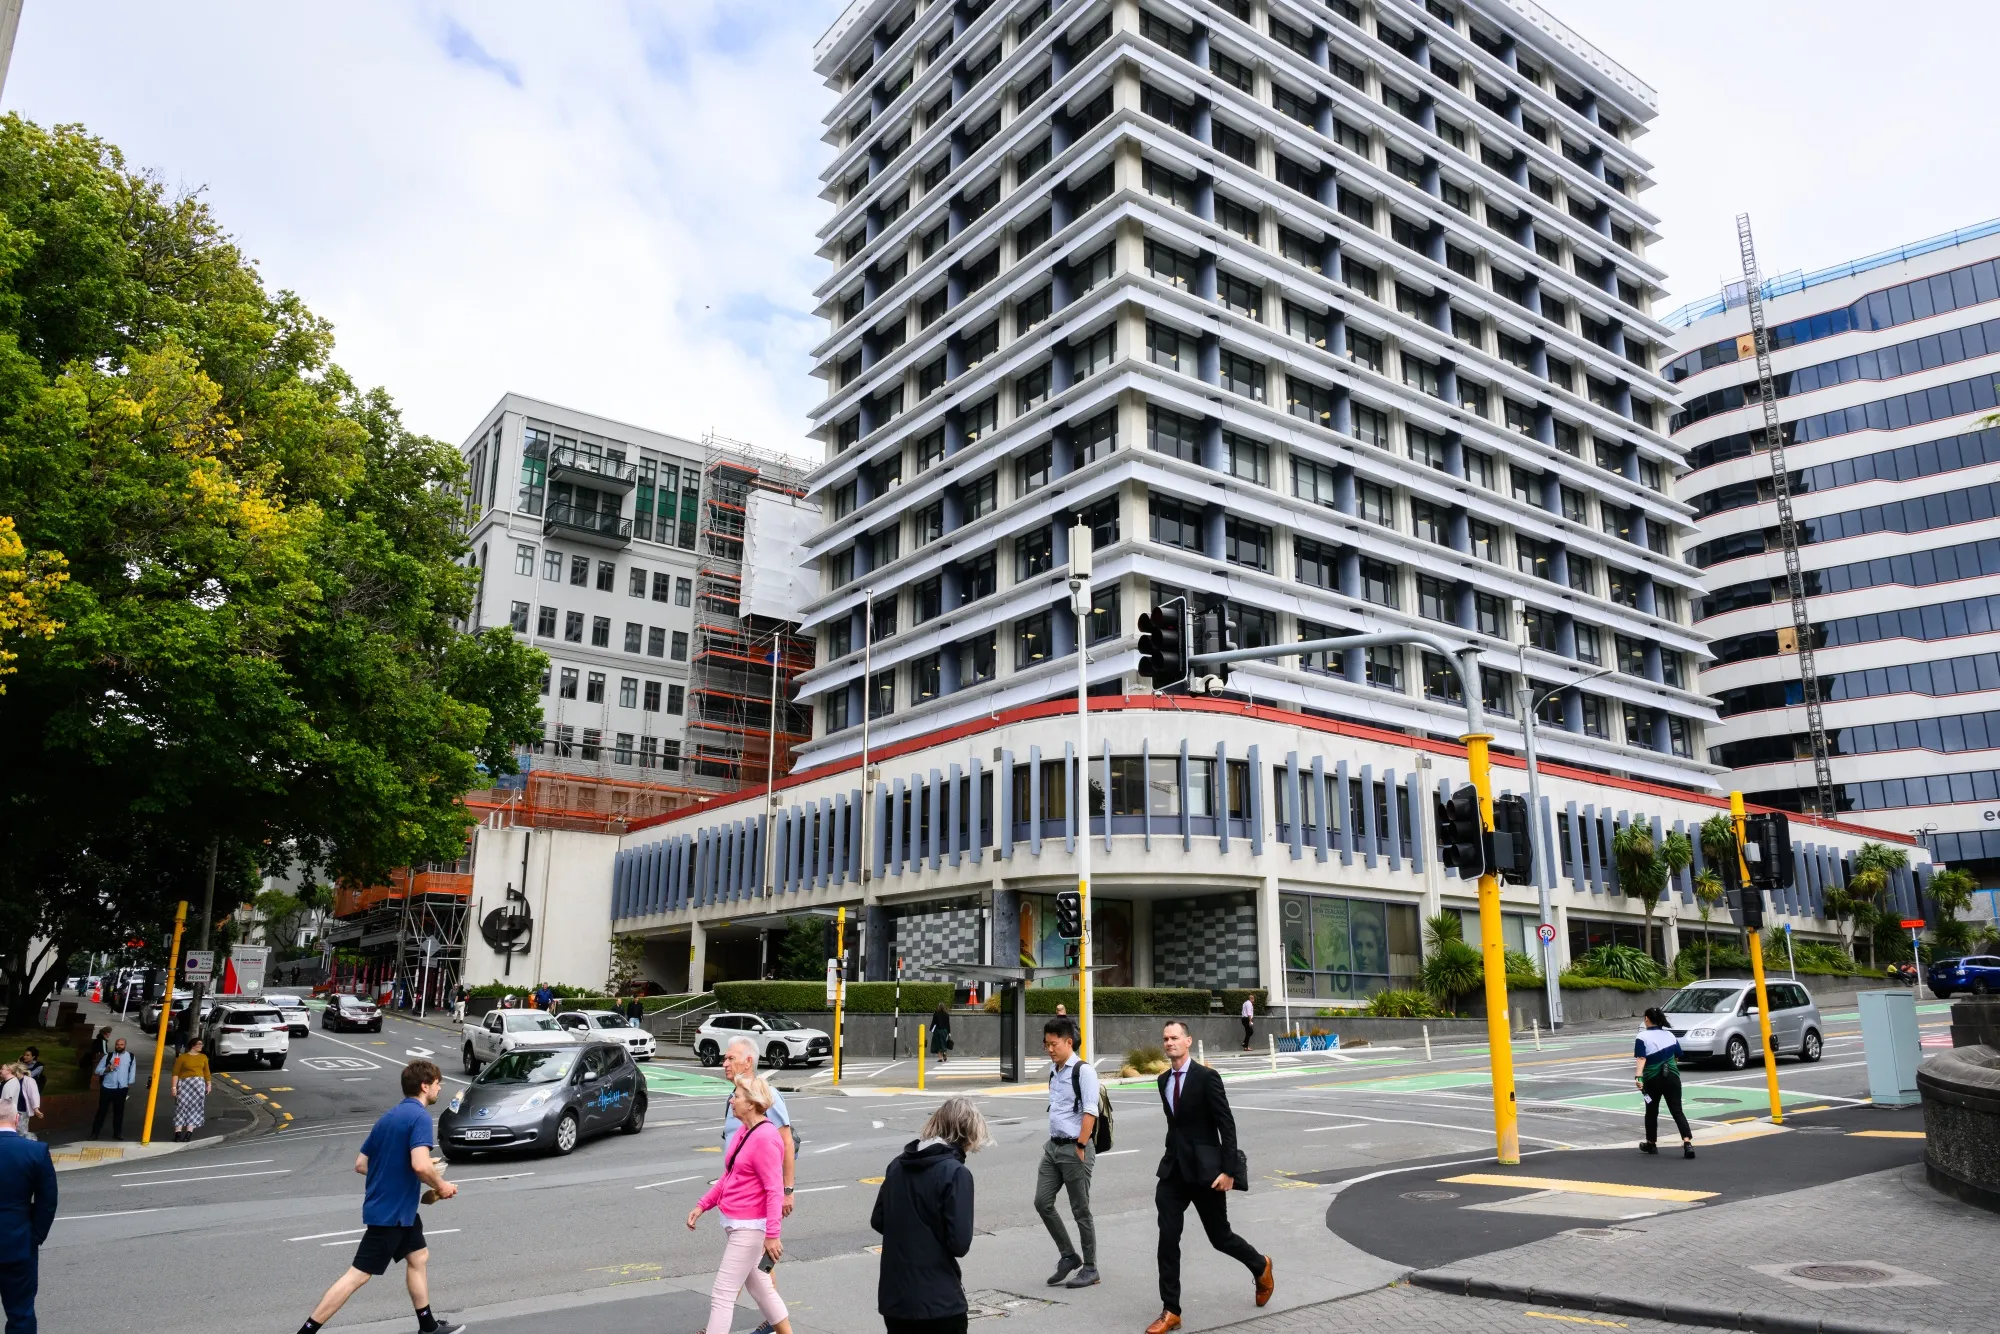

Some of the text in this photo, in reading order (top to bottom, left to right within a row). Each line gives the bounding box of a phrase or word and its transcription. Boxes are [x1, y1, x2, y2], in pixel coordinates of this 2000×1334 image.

[1983, 809, 2000, 821] e
[1326, 964, 1351, 992] 10
[466, 1130, 491, 1139] LKZ298
